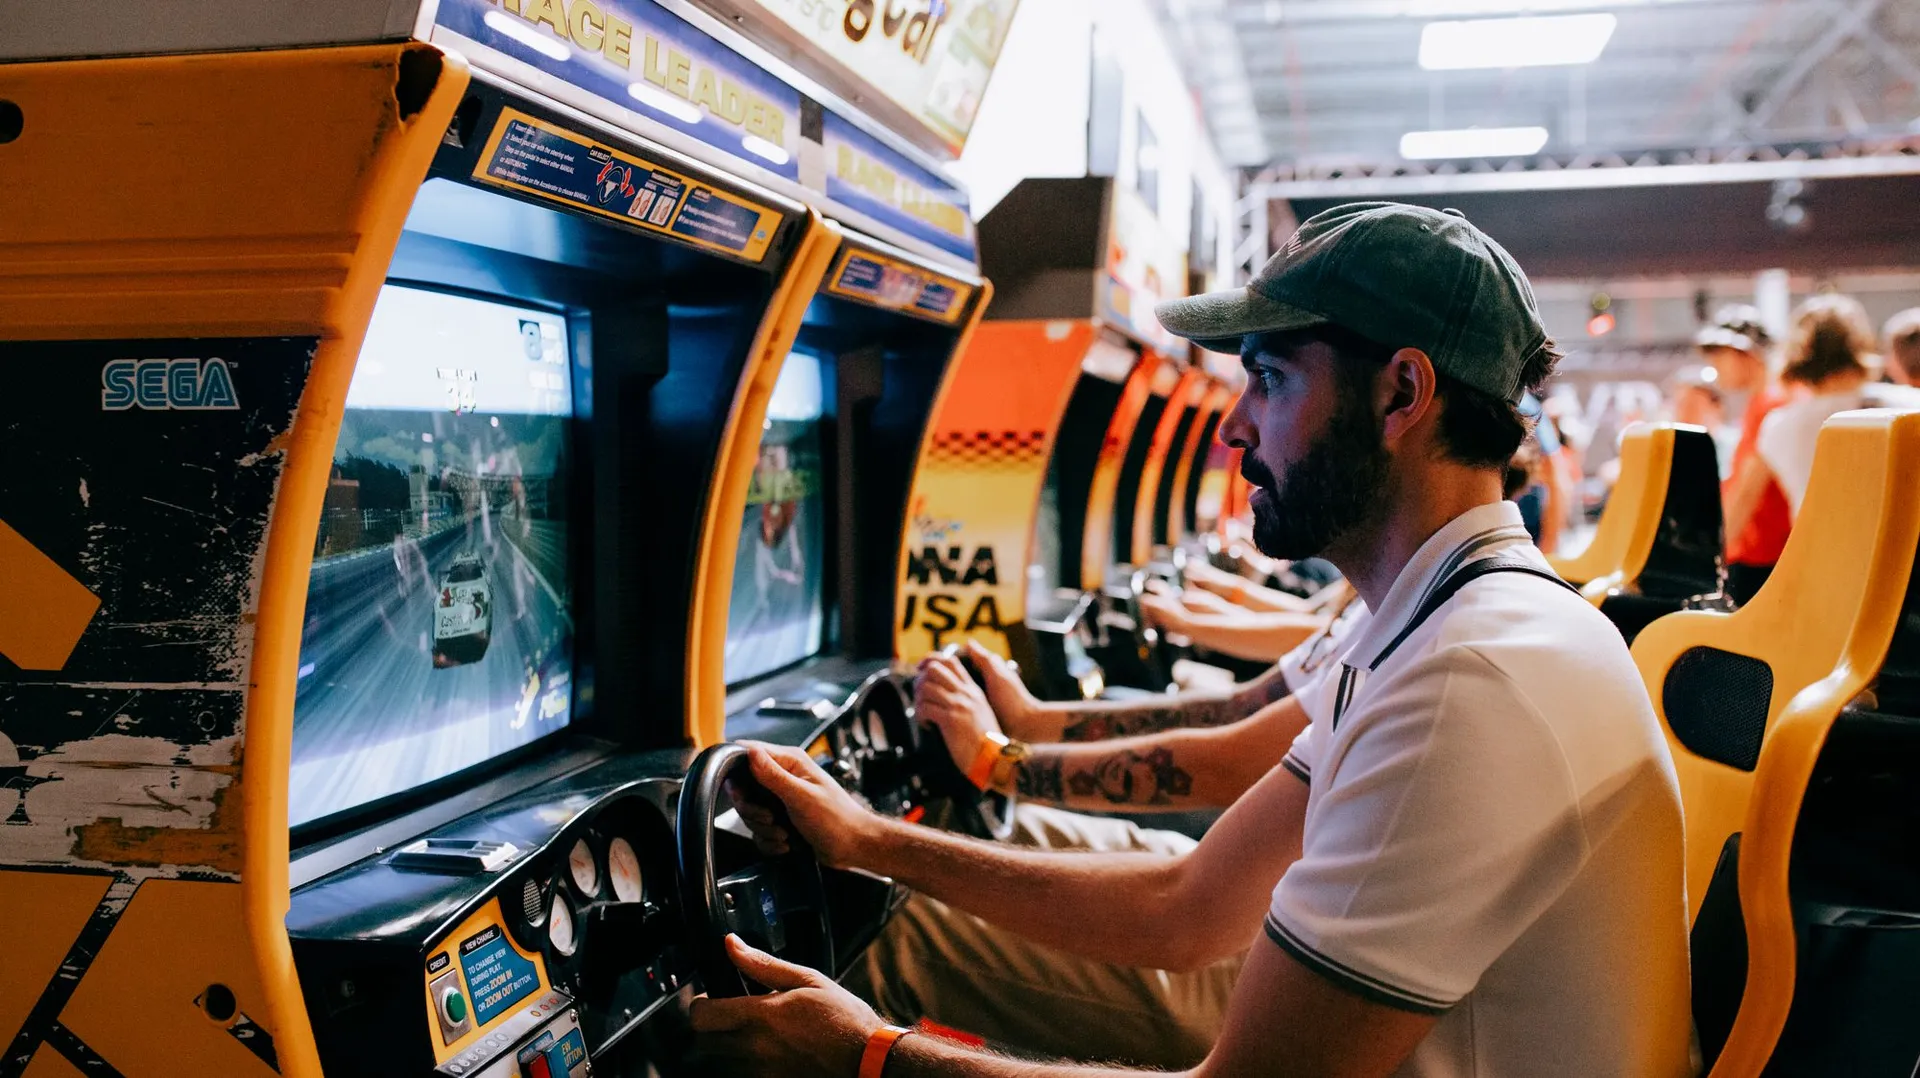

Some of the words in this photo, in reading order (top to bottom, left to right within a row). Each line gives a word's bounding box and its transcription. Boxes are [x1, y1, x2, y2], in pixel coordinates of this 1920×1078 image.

[485, 0, 633, 70] ACE
[642, 33, 786, 148] LEADER
[101, 357, 241, 411] SEGA
[464, 940, 477, 950] VIEW
[476, 930, 494, 946] CHANGE
[429, 956, 447, 971] CREDIT
[468, 966, 476, 975] TO
[476, 954, 496, 972] CHANGE
[494, 948, 506, 960] VIEW
[470, 970, 490, 986] DURING
[474, 984, 491, 999] PRESS
[490, 974, 506, 990] ZOOM
[506, 968, 514, 980] IN
[478, 1002, 486, 1012] OR
[484, 992, 502, 1008] ZOOM
[502, 983, 514, 997] OUT
[561, 1039, 572, 1056] EW
[564, 1045, 583, 1068] UTTON
